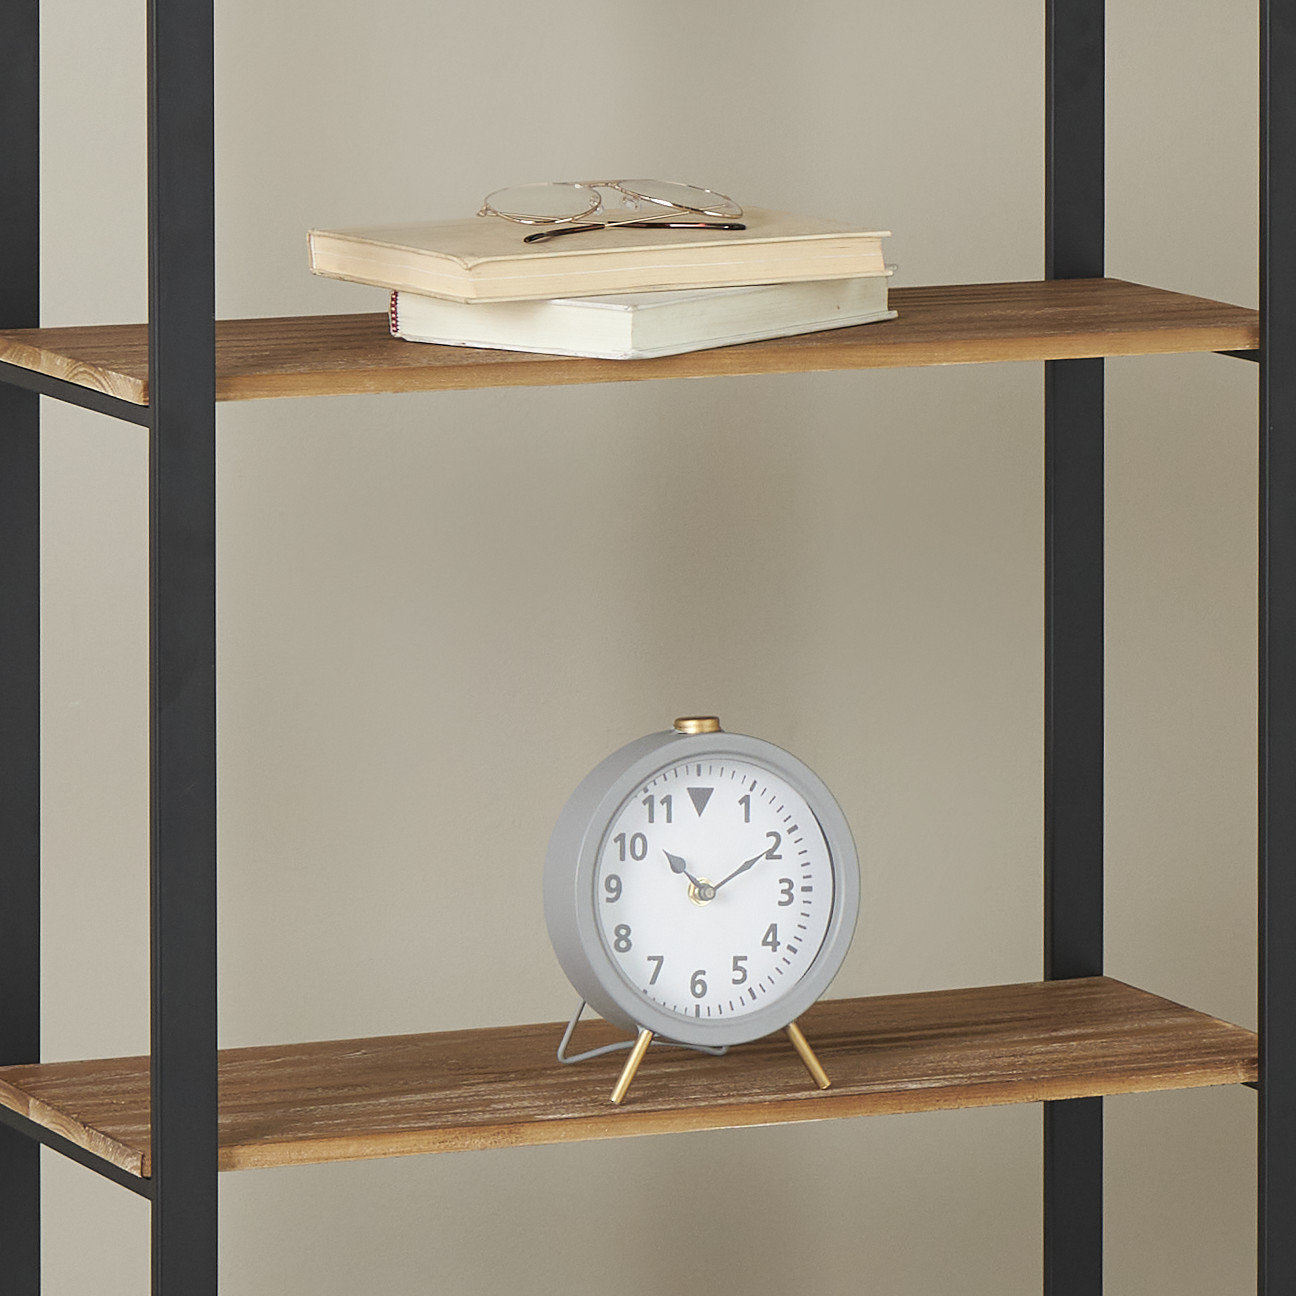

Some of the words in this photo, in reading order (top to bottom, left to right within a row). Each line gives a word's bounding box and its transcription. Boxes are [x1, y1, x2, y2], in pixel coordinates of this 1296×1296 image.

[642, 794, 673, 824] 11
[738, 794, 751, 823] 1
[613, 832, 648, 861] 10
[765, 831, 783, 860] 2
[605, 873, 622, 903] 9
[777, 877, 795, 906] 3
[614, 924, 632, 953] 8
[761, 923, 781, 952] 4
[646, 955, 664, 985] 7
[690, 969, 708, 998] 6
[731, 955, 748, 985] 5
